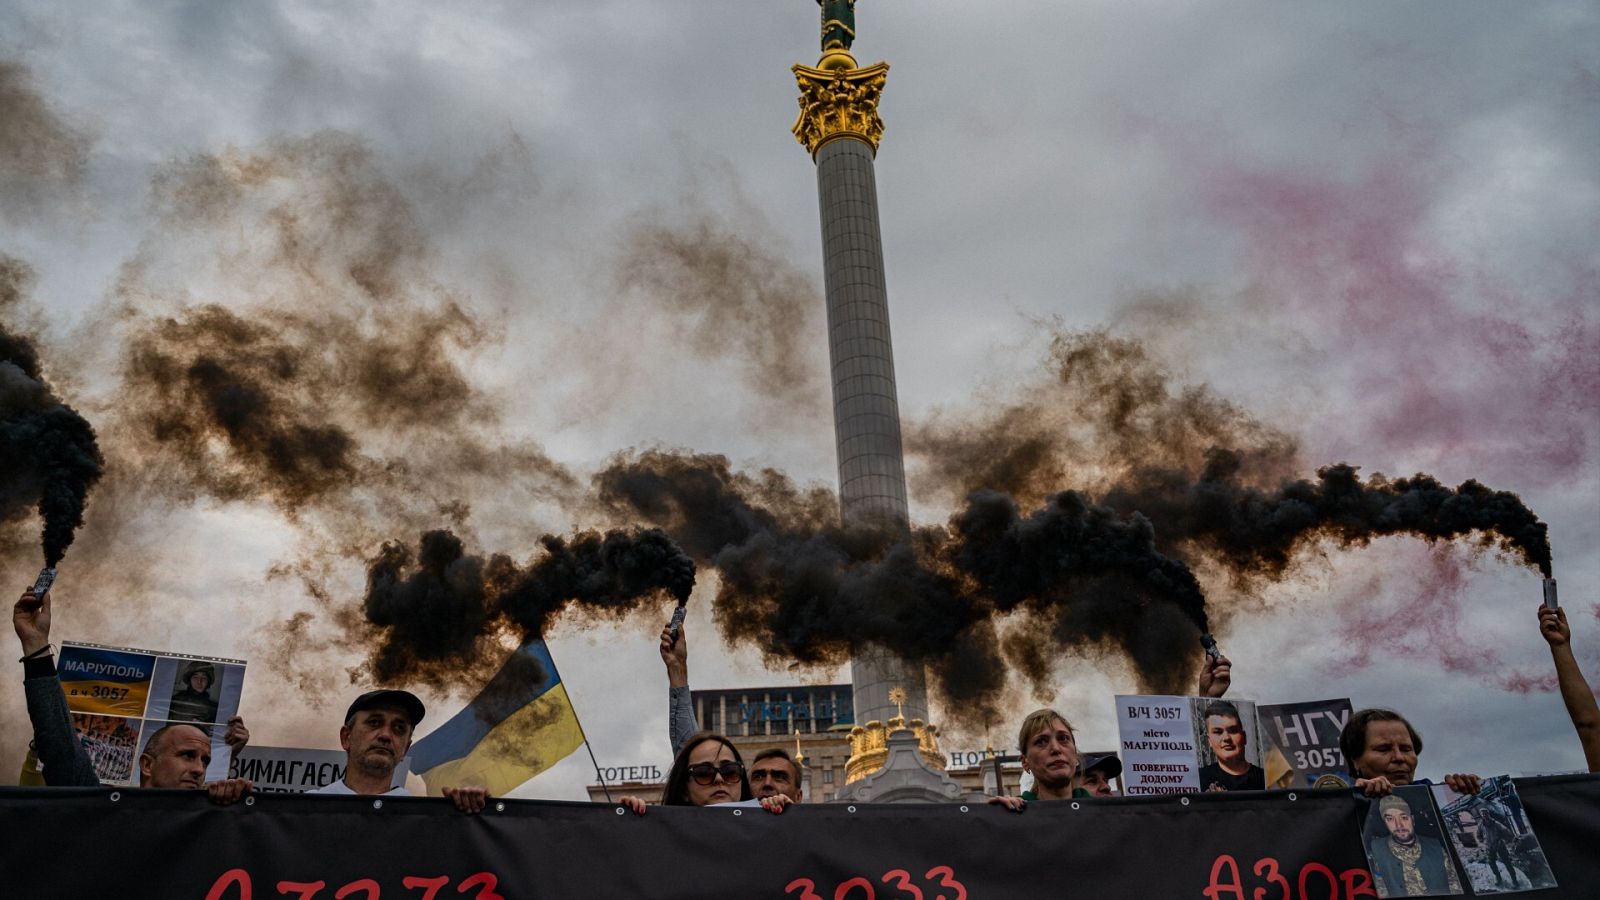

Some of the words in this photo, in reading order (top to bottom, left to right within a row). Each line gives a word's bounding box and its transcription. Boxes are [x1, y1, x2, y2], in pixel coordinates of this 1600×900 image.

[64, 660, 145, 679] МАРІУПОЛЬ
[90, 685, 130, 701] 3057
[1128, 707, 1151, 719] В/Ч
[1154, 707, 1182, 720] 3057
[1143, 729, 1170, 738] місто
[1273, 709, 1350, 748] НГУ
[1124, 741, 1193, 752] МАРІУПОЛЬ
[951, 749, 1006, 766] HOT
[1294, 747, 1345, 770] 3057
[597, 766, 662, 783] ГОТЕЛЬ
[1132, 763, 1190, 773] ПОВЕРНІТЬ
[1140, 775, 1184, 785] ДОДОМУ
